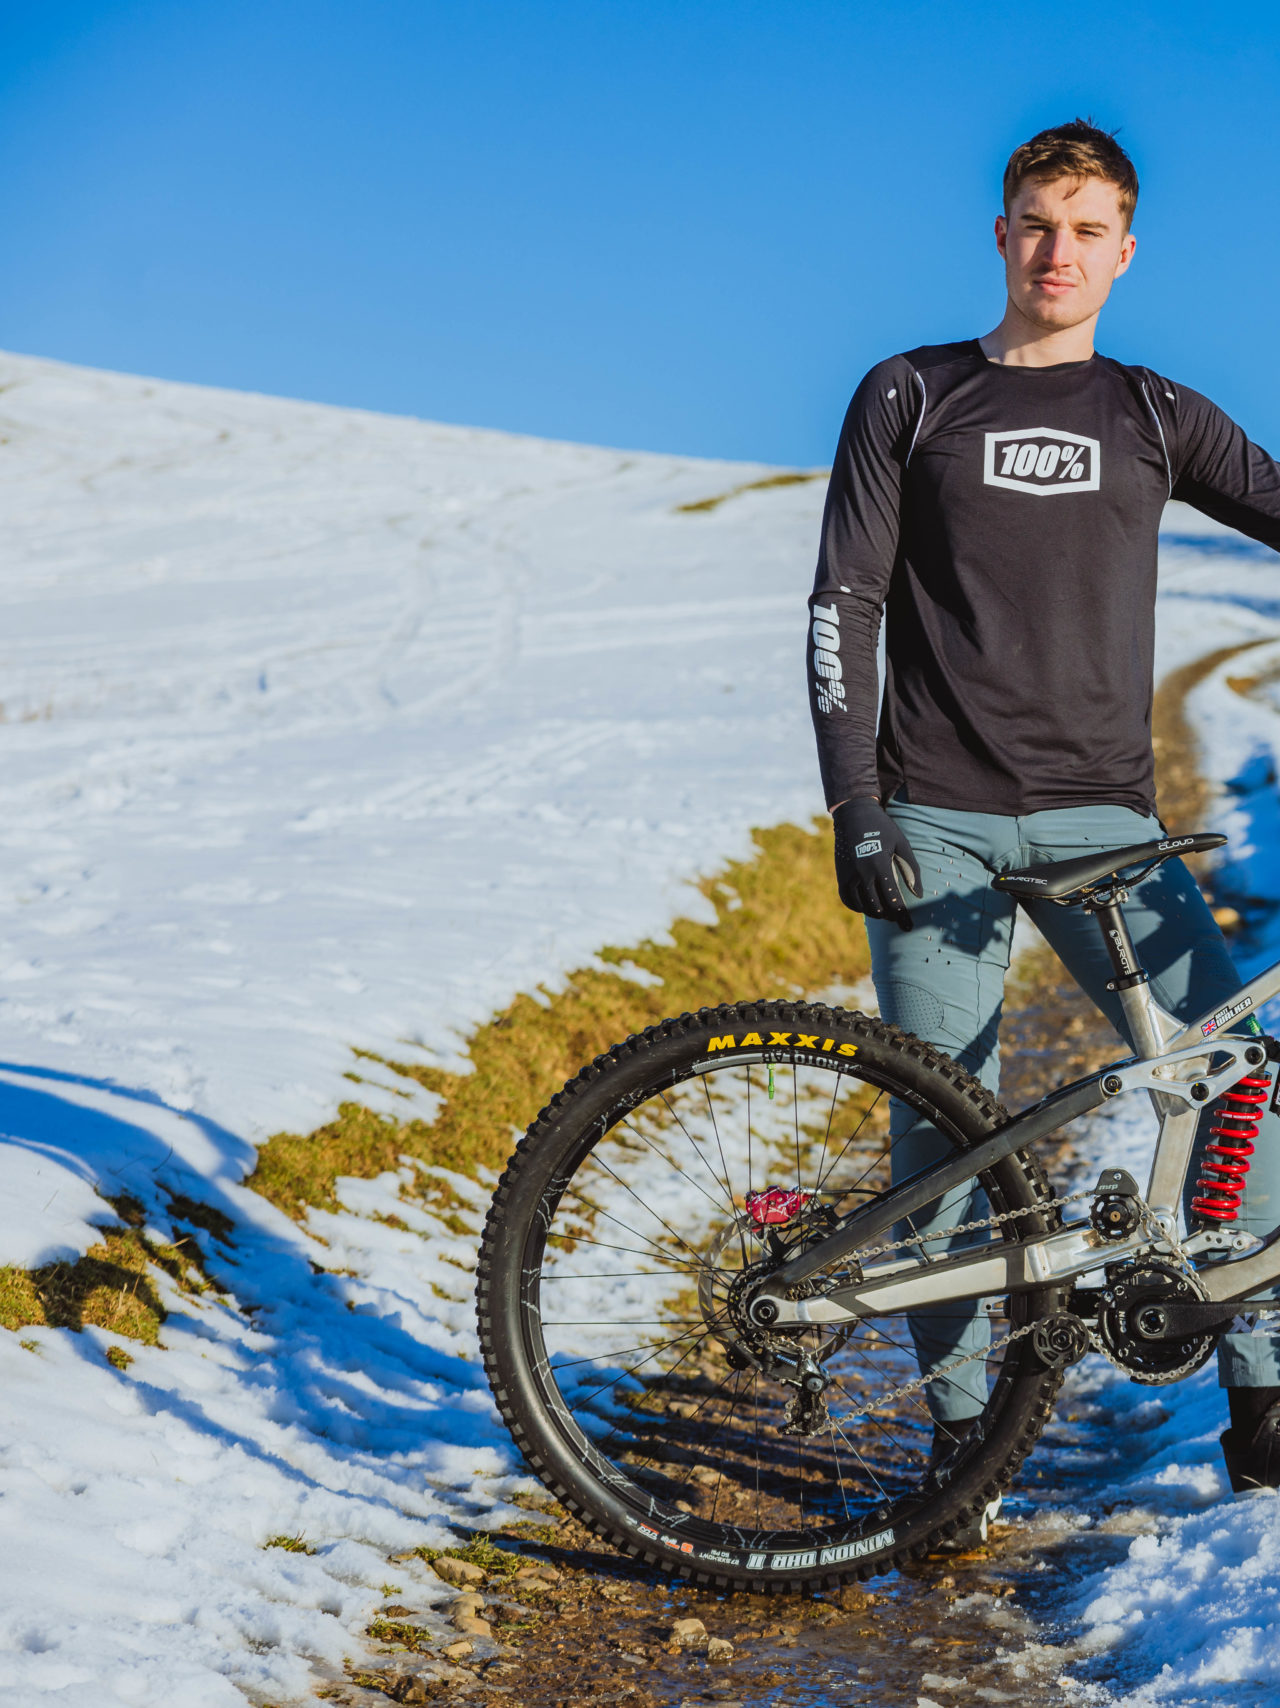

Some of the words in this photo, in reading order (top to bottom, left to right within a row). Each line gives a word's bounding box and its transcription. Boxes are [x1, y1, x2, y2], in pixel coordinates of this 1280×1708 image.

[1000, 443, 1085, 480] 100%
[813, 603, 848, 714] 100%
[859, 842, 878, 855] 100%
[1158, 838, 1194, 851] CLOUD
[707, 1032, 859, 1057] MAXXIS
[820, 1528, 895, 1565] MINION
[746, 1553, 767, 1570] II
[771, 1550, 818, 1571] DHR
